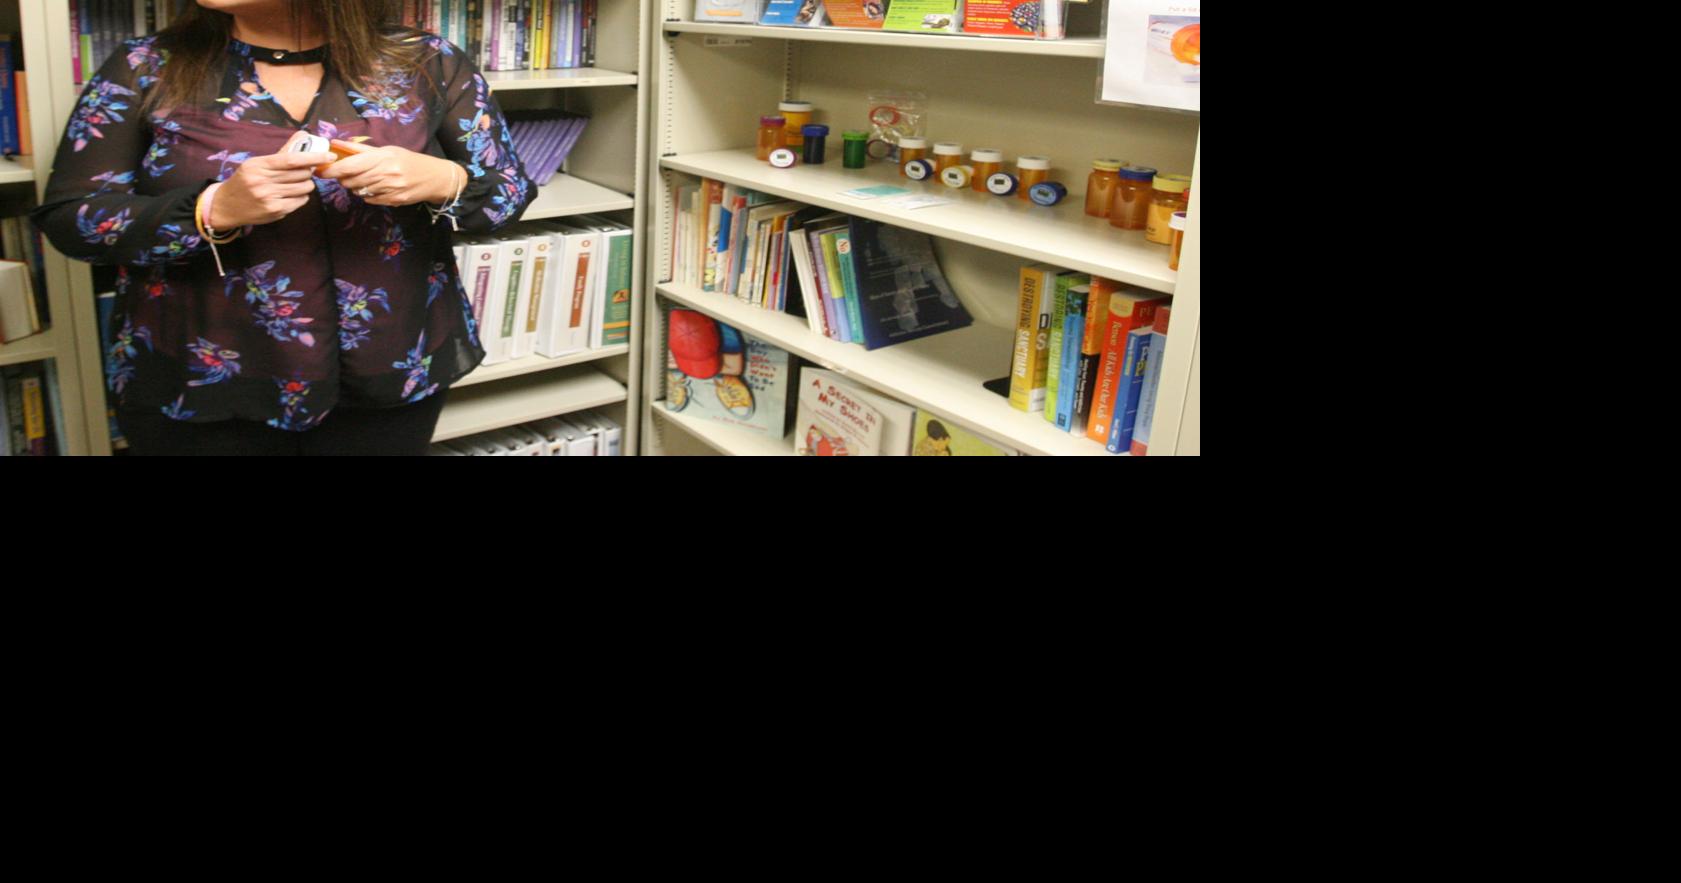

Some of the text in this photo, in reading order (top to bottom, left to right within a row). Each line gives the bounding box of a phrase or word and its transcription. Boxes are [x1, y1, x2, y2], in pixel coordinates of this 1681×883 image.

[1015, 277, 1036, 378] DESTROYING SANCTUARY
[812, 379, 821, 389] A
